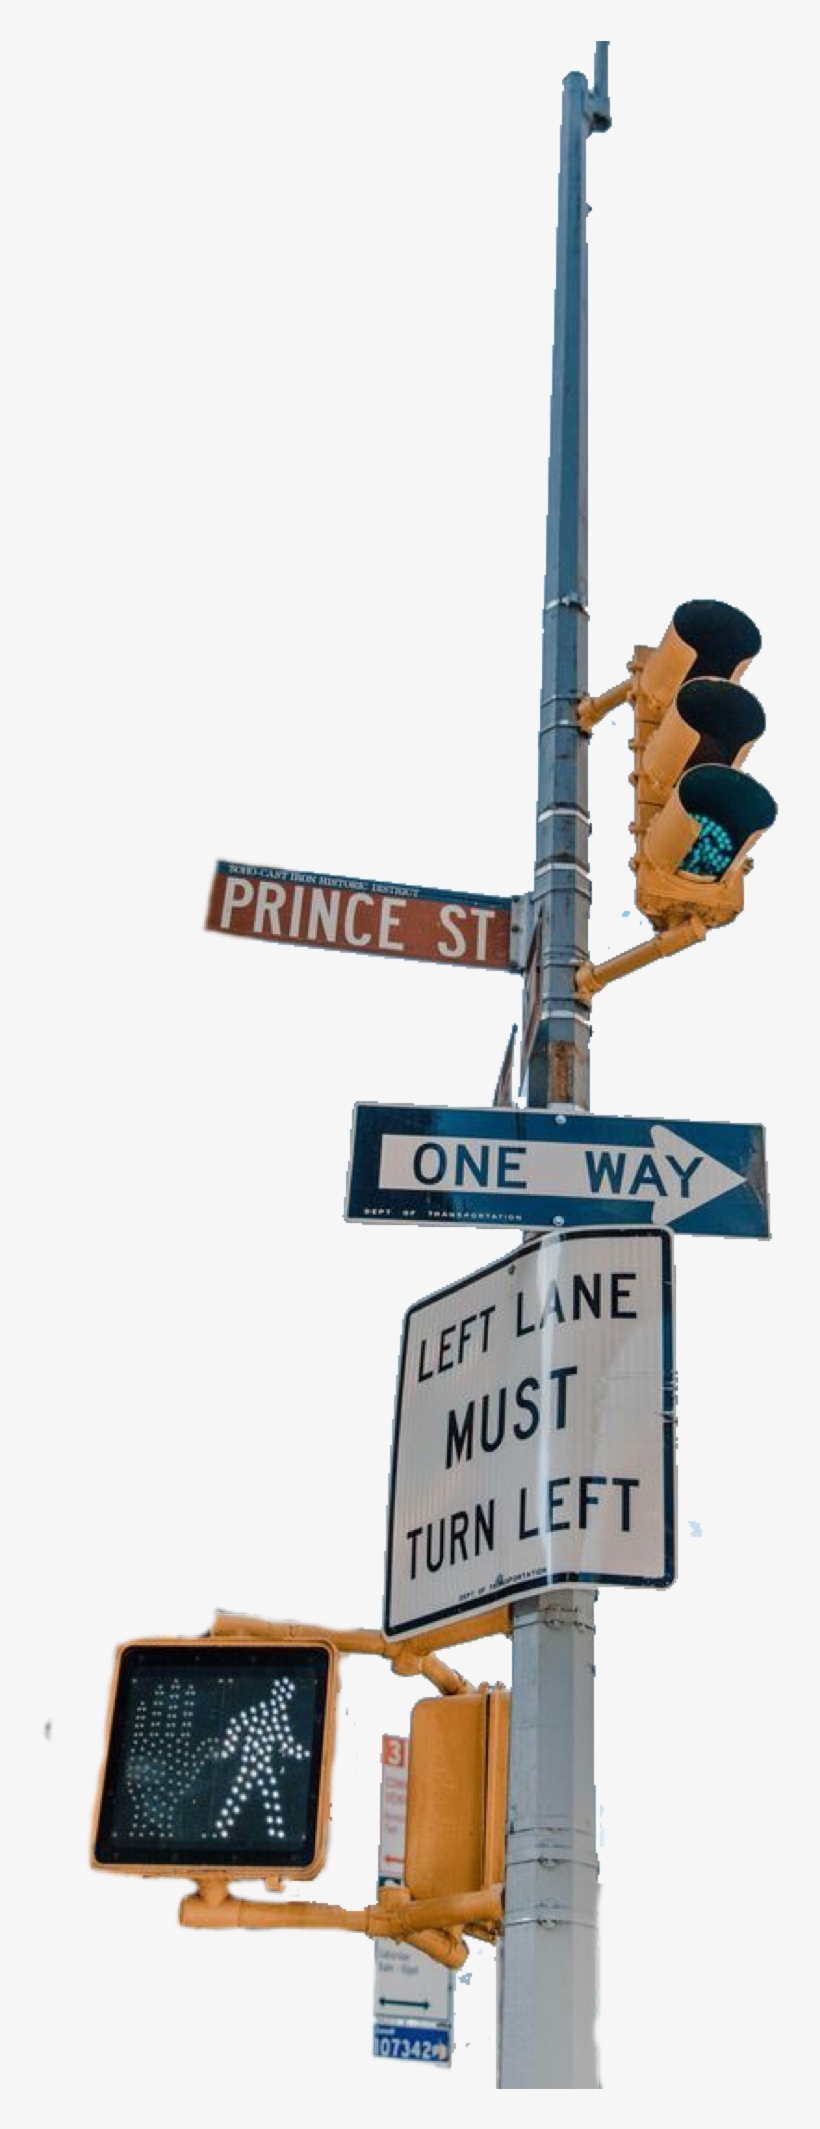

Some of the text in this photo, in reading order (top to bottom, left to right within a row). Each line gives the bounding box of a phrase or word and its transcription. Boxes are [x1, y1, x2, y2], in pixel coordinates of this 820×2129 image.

[220, 876, 496, 961] PRINCE ST
[290, 872, 316, 883] IRON
[319, 875, 370, 890] HISTORIC
[372, 883, 419, 898] DISTRICT
[413, 1142, 704, 1198] ONE WAY
[428, 1210, 522, 1221] TRANSPORTATION
[418, 1272, 638, 1383] LEFT LANE
[445, 1366, 578, 1470] MUST
[407, 1476, 640, 1580] TURN LEFT
[388, 1740, 402, 1765] 3
